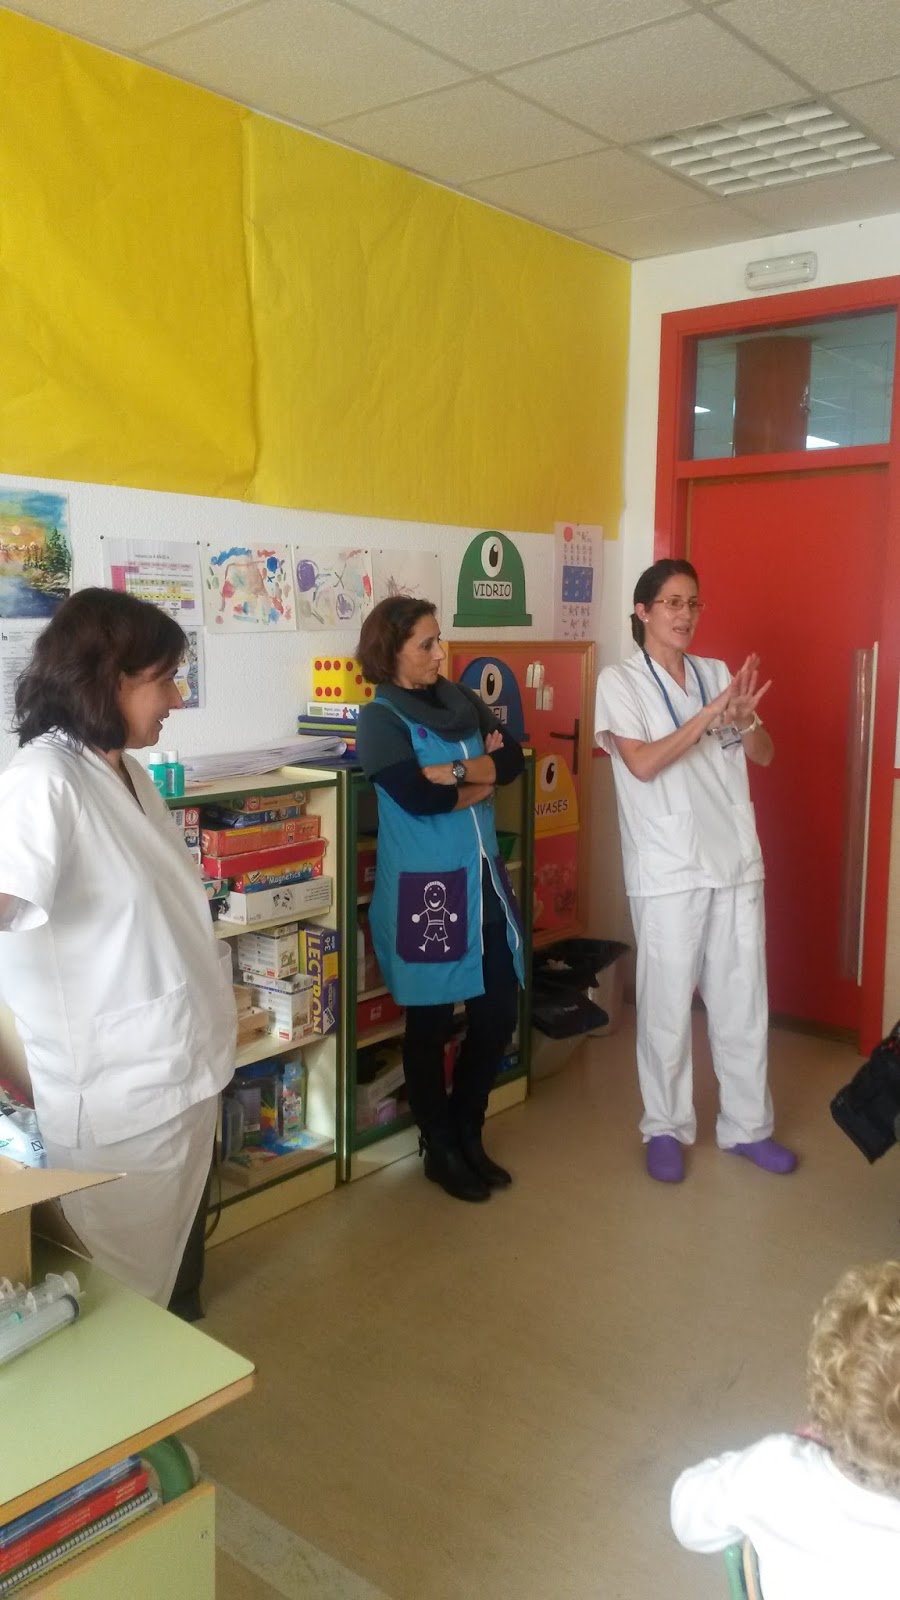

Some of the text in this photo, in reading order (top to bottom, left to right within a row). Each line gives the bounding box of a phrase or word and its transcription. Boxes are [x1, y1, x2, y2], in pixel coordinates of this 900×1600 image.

[473, 583, 512, 597] VIDRIO
[534, 799, 568, 816] NVASES
[268, 871, 301, 885] Magnetics
[308, 936, 322, 1034] LECTRON
